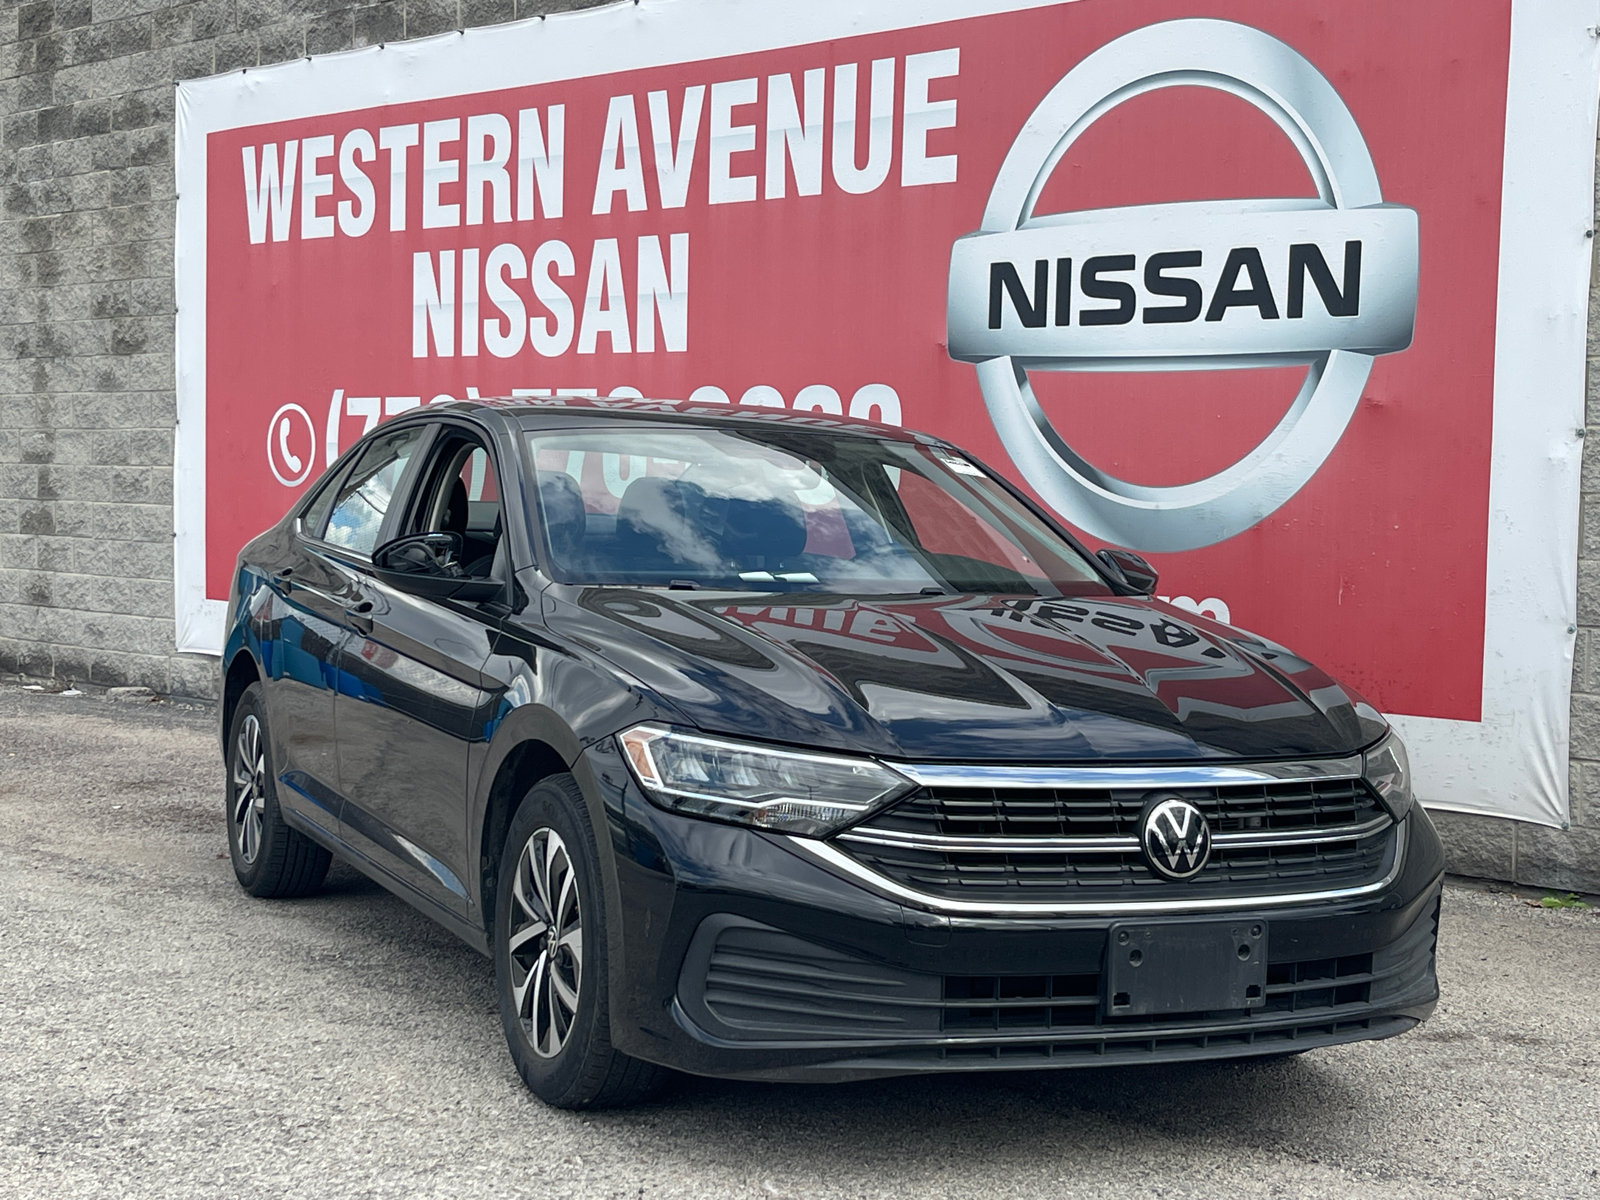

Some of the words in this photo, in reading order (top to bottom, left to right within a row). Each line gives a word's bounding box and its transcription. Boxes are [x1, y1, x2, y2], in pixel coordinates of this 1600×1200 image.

[241, 103, 565, 245] WESTERN
[591, 47, 960, 216] AVENUE
[412, 232, 690, 359] NISSAN
[988, 240, 1362, 330] NISSAN
